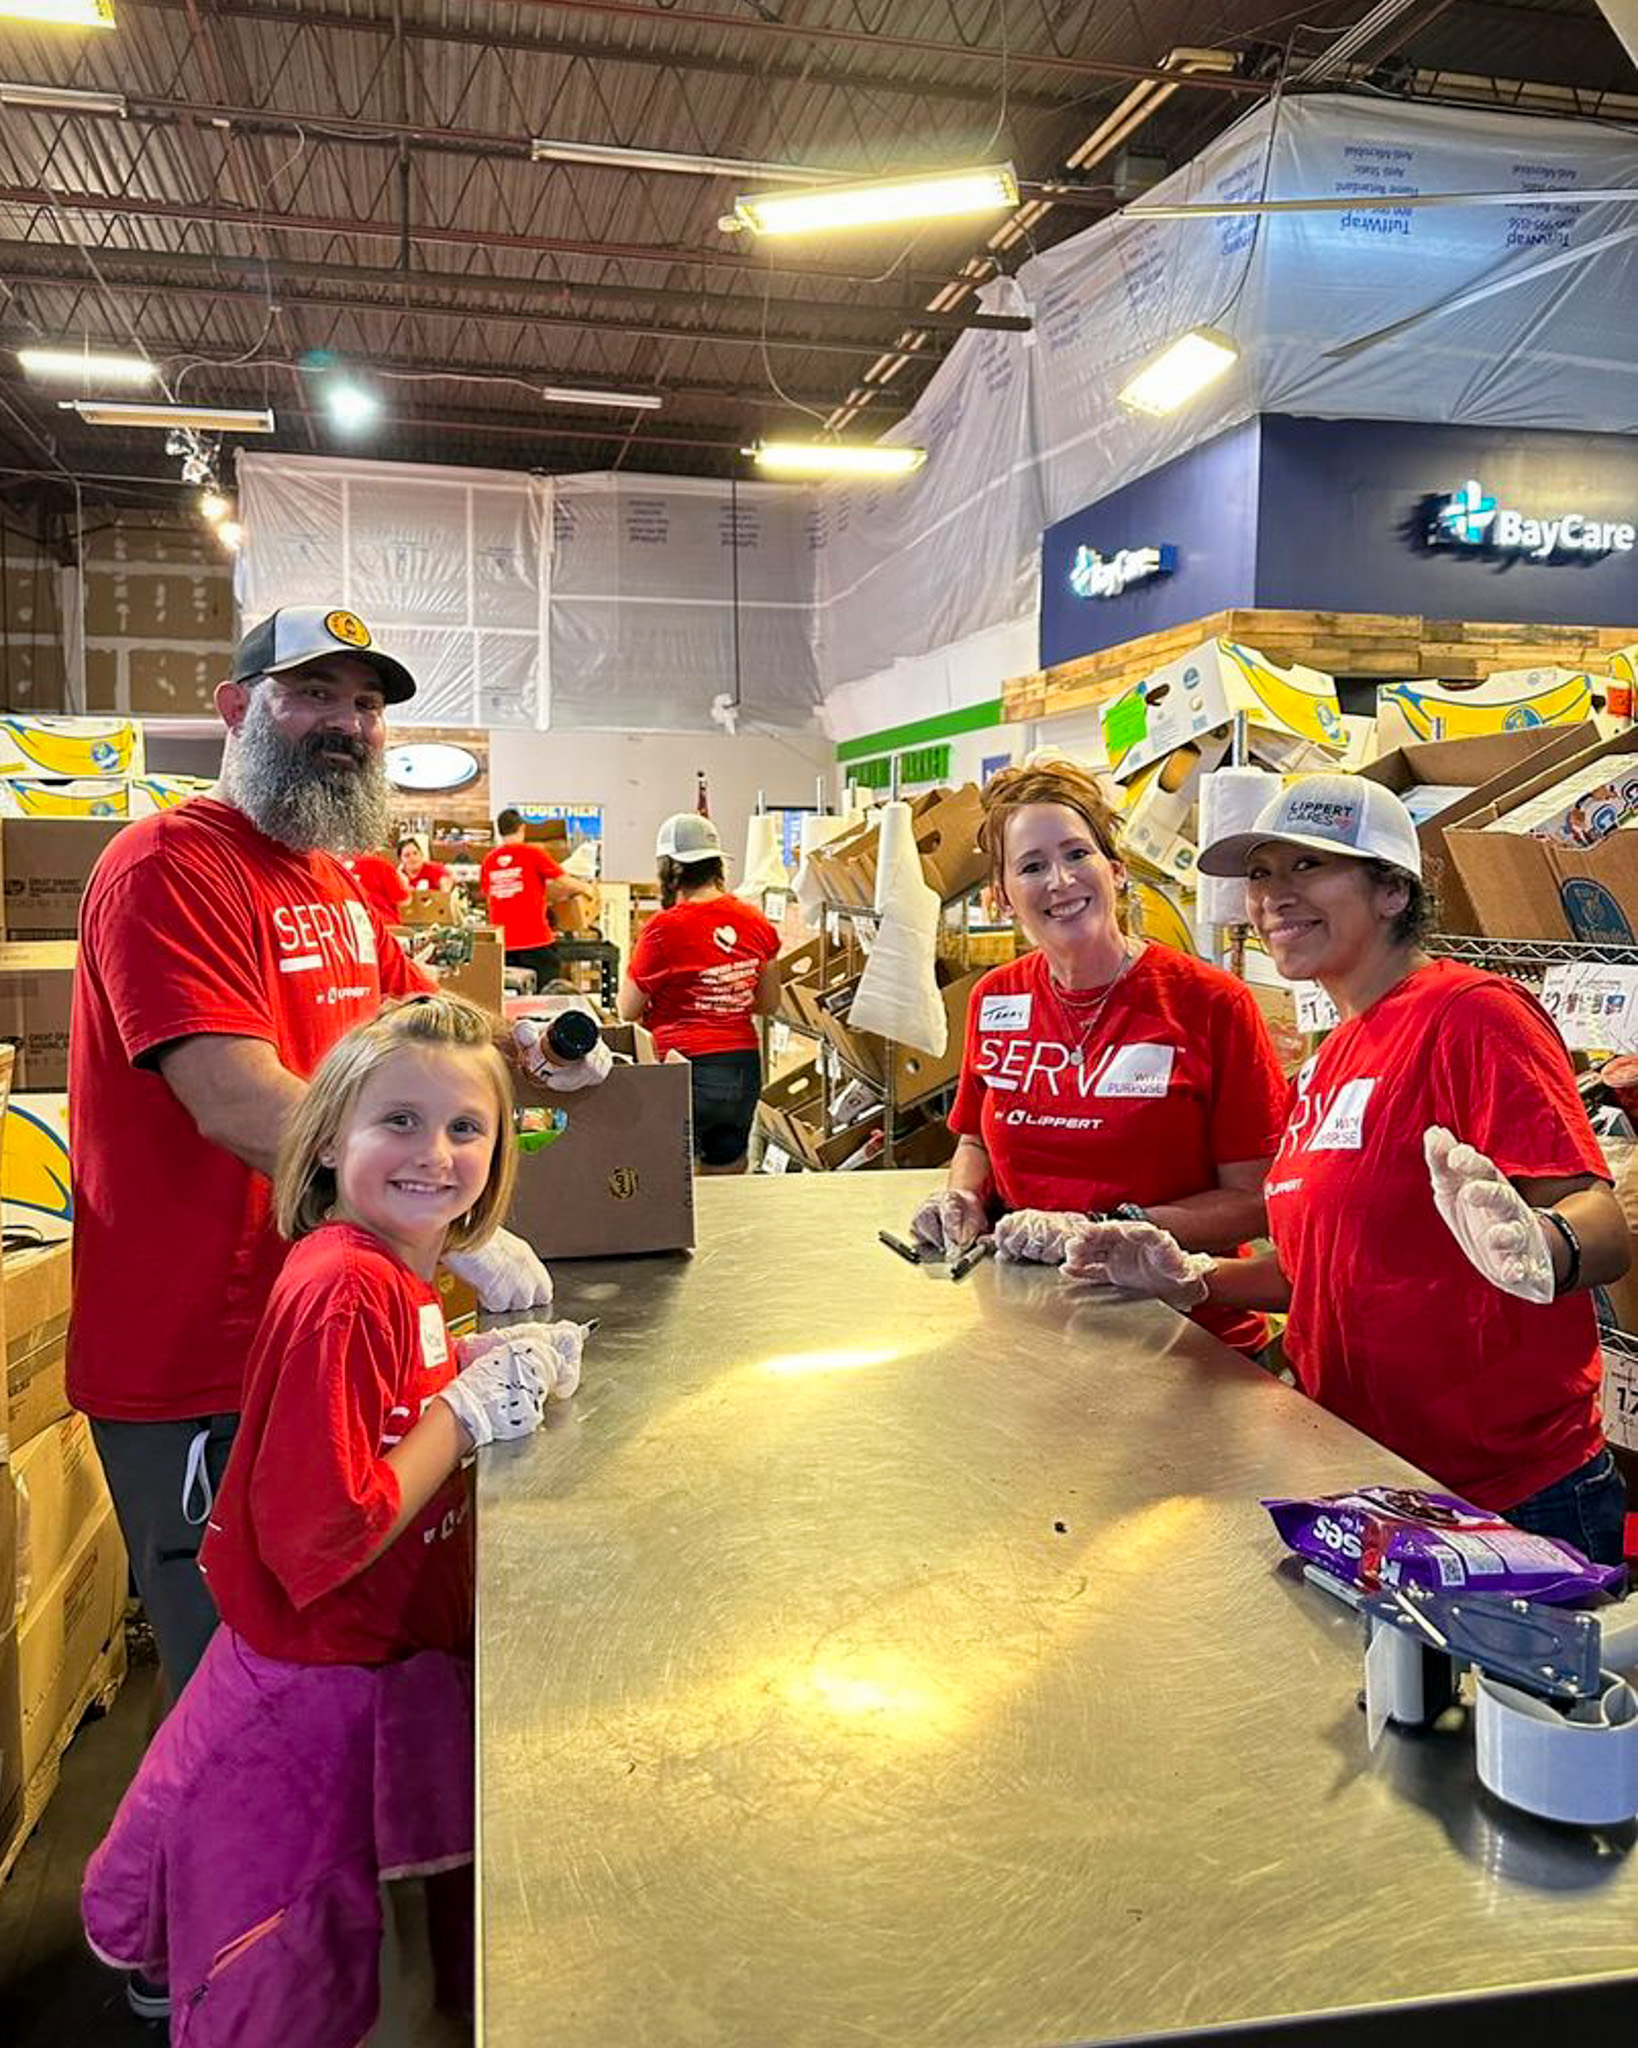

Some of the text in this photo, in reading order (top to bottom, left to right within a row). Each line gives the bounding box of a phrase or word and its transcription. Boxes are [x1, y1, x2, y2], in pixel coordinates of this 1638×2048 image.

[1494, 510, 1635, 557] BayCare
[1290, 801, 1353, 817] LIPPERT
[1286, 811, 1333, 827] CARES
[1107, 1083, 1166, 1094] PURPOSE
[1025, 1113, 1104, 1129] LIPPERT
